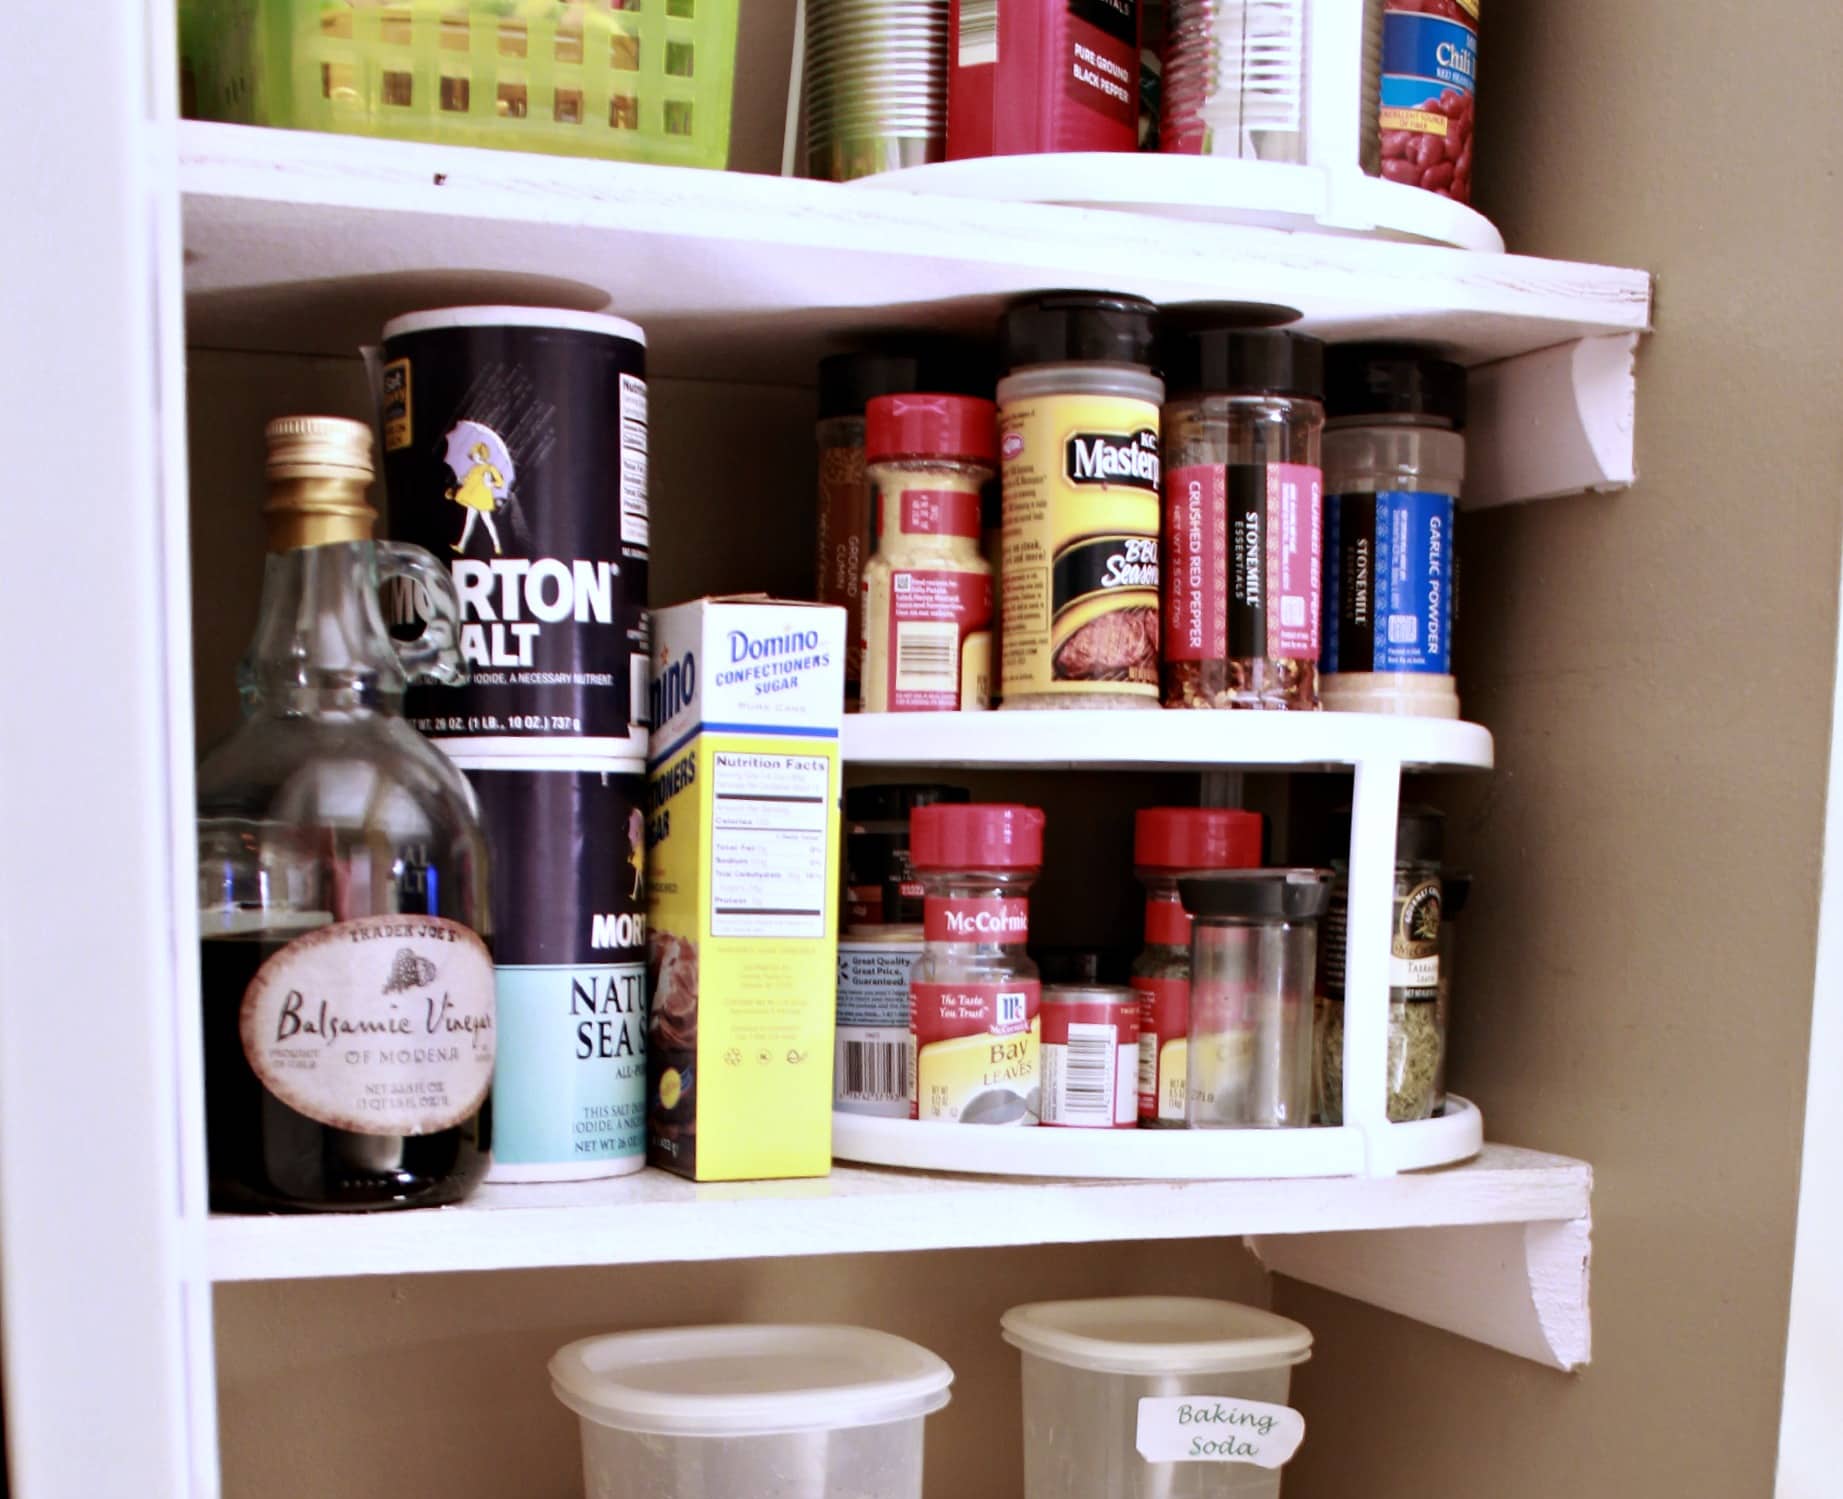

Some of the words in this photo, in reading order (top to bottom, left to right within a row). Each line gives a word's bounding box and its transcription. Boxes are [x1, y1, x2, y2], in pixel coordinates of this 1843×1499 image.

[1073, 42, 1097, 66] PURE
[1096, 55, 1129, 84] GROUND
[1435, 42, 1472, 76] Chili
[1073, 63, 1100, 90] BLACK
[1100, 77, 1130, 104] PEPPER
[1188, 480, 1202, 551] CRUSHED
[1235, 520, 1245, 599] ESSENTIALS
[1246, 511, 1259, 608] STONEMILL
[1429, 516, 1442, 575] GARLIC
[1188, 554, 1202, 588] RED
[1355, 537, 1368, 625] STONEMILL
[1189, 591, 1203, 648] PEPPER
[1427, 579, 1440, 654] POWDER
[459, 622, 541, 668] ALT
[728, 631, 819, 663] Domino
[510, 673, 517, 684] A
[518, 673, 571, 685] NECESSARY
[716, 654, 831, 687] CONFECTIONERS
[755, 677, 798, 695] SUGAR
[716, 756, 781, 769] Nutrition
[785, 759, 825, 771] Facts
[351, 924, 412, 943] TRADER
[941, 994, 955, 1006] The
[959, 994, 983, 1006] Taste
[276, 989, 416, 1047] Balsamic
[344, 1050, 370, 1065] OF
[379, 1047, 460, 1064] MODENA
[576, 1018, 634, 1060] SEA
[990, 1040, 1028, 1066] Bay
[983, 1062, 1032, 1086] LEAVES
[575, 1140, 596, 1153] NET
[600, 1138, 616, 1151] WT
[1178, 1404, 1276, 1436] Baking
[1189, 1435, 1258, 1456] Soda
